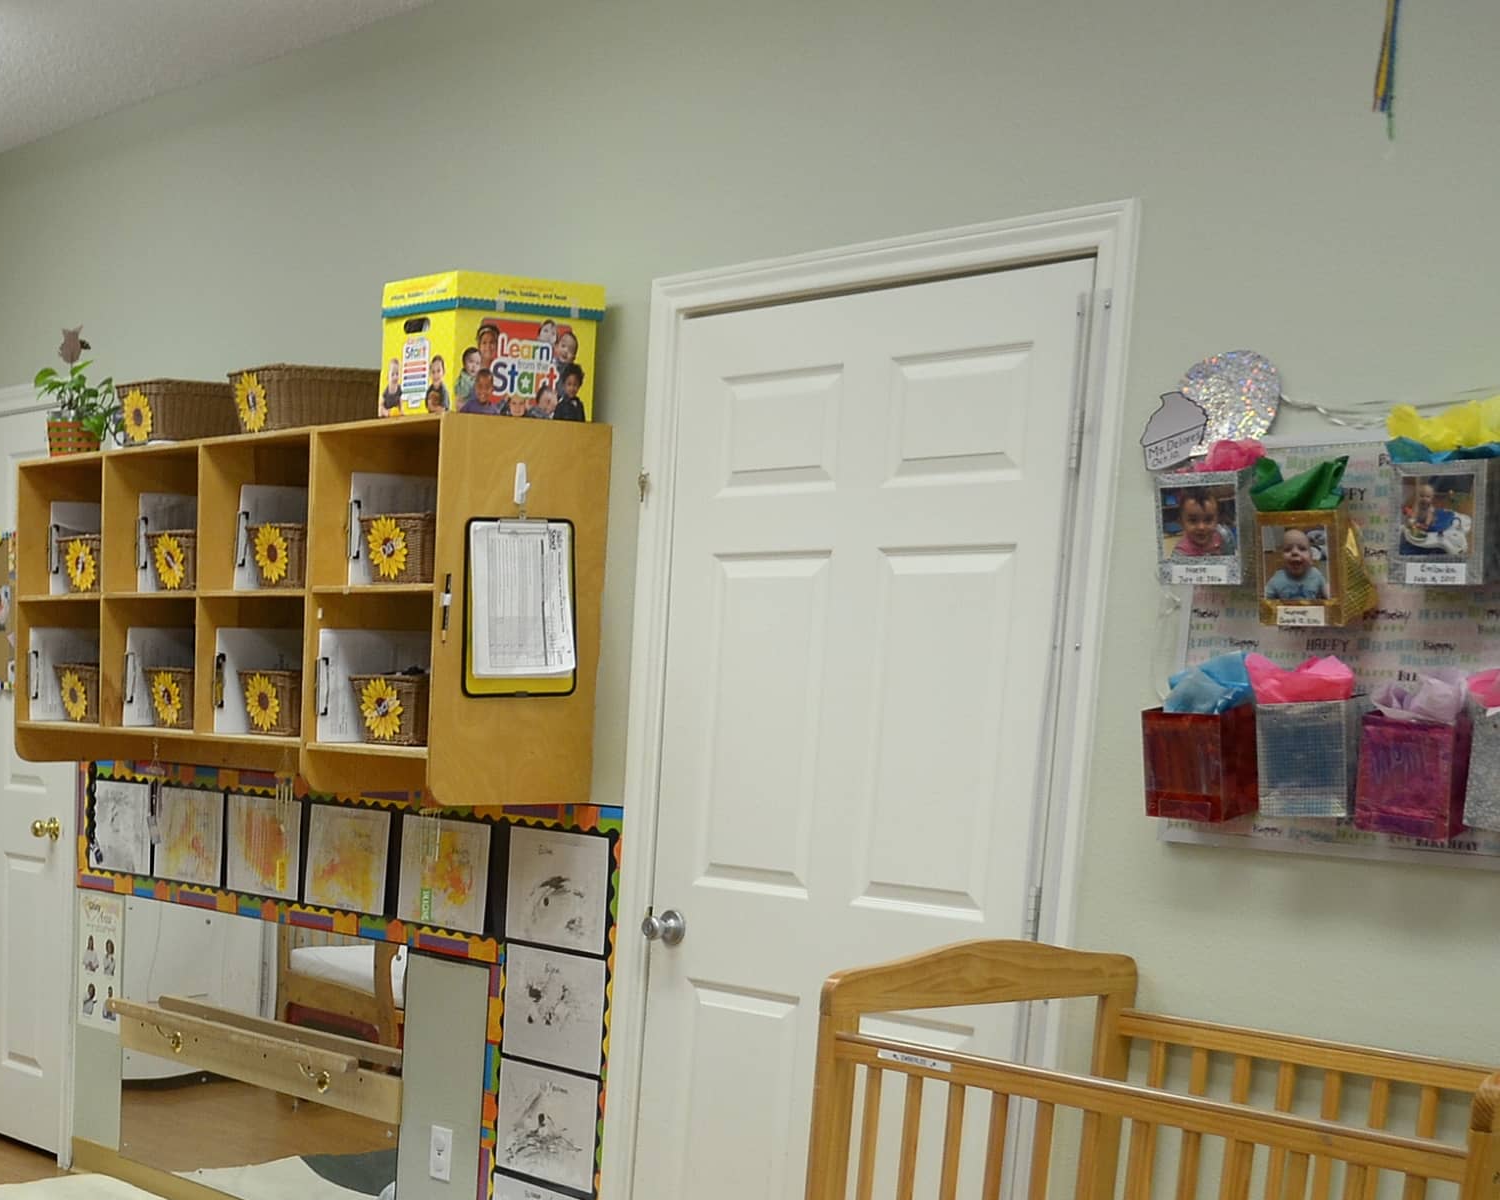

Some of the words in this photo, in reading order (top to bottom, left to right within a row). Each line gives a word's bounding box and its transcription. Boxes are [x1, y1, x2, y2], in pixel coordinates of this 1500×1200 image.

[405, 346, 426, 359] Start
[500, 335, 552, 360] Learn
[493, 361, 558, 395] Start
[1306, 638, 1350, 652] HAPPY
